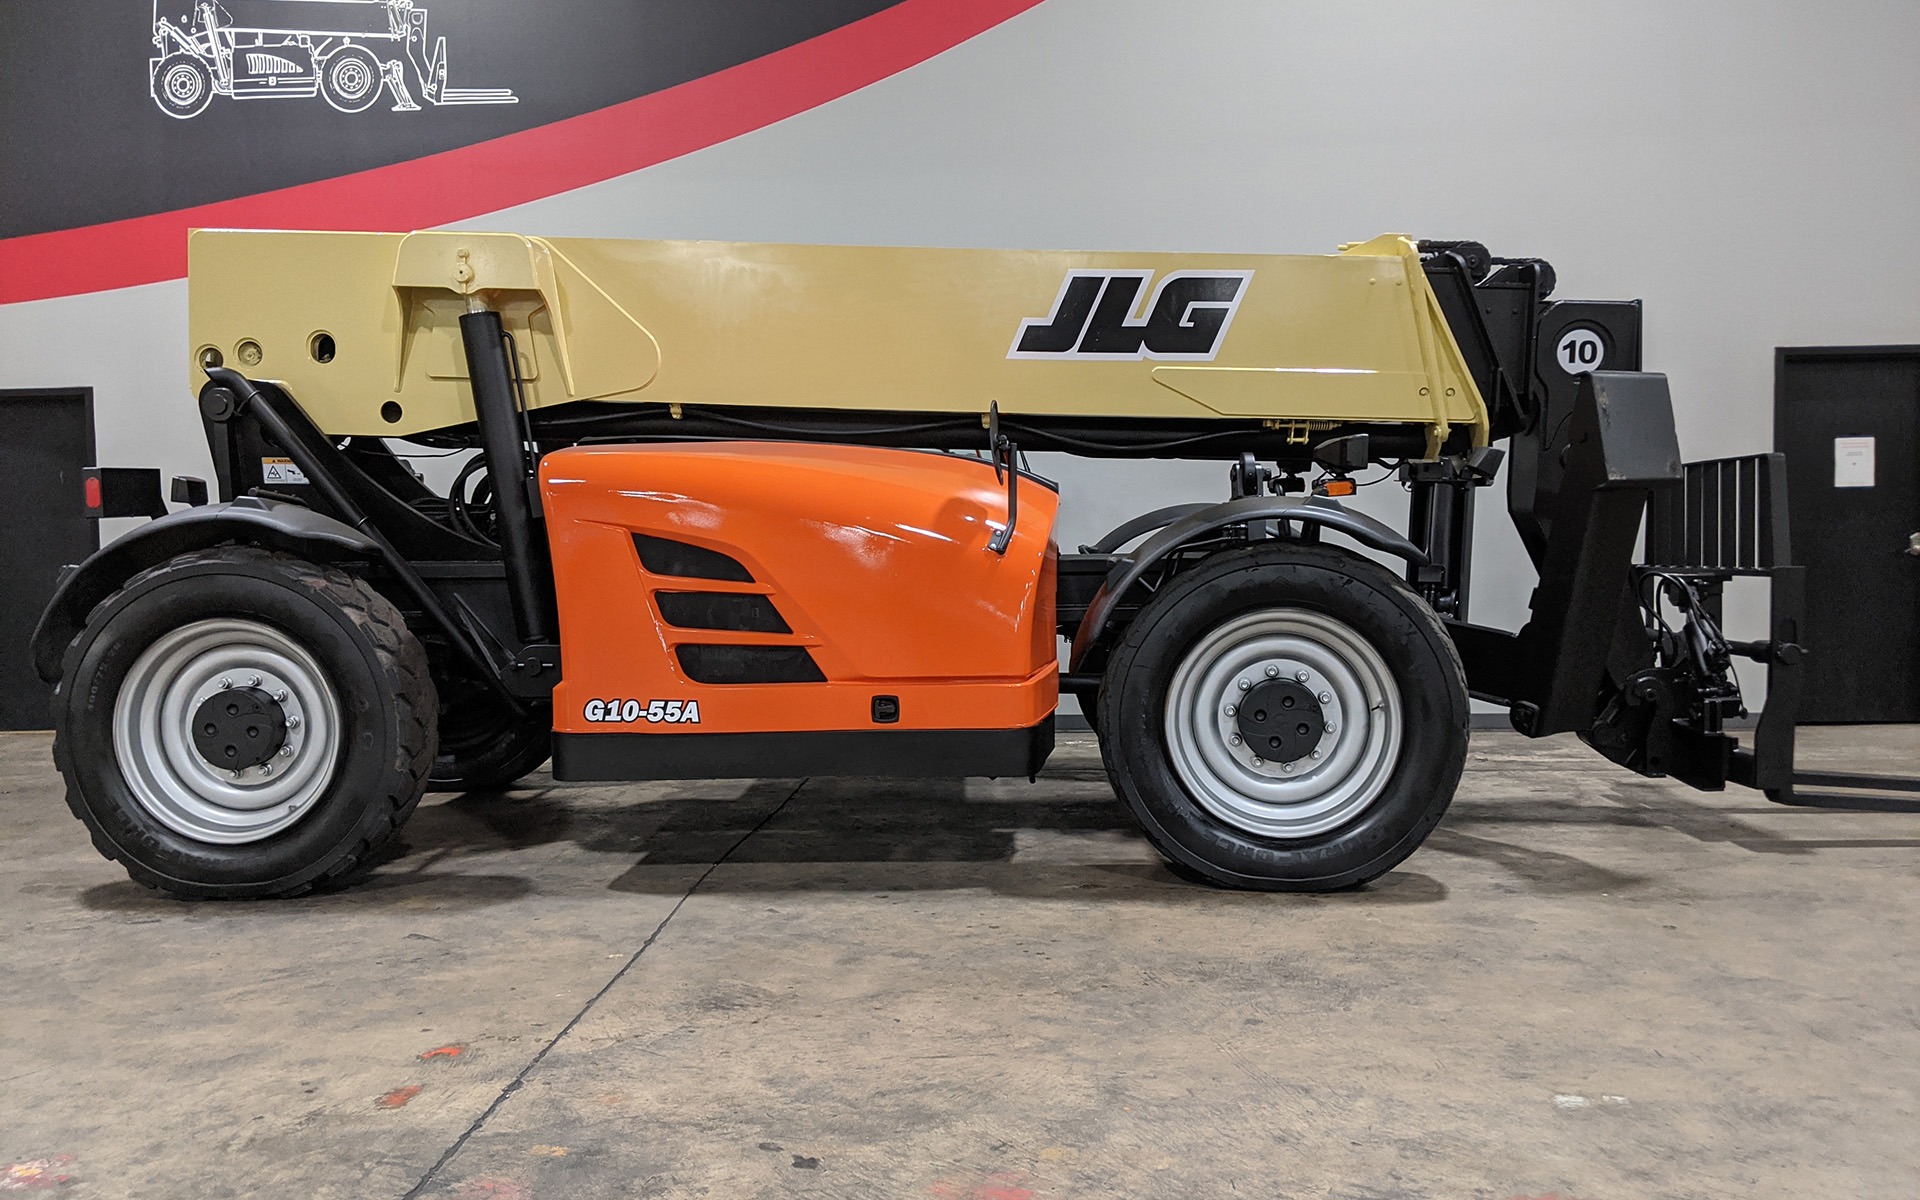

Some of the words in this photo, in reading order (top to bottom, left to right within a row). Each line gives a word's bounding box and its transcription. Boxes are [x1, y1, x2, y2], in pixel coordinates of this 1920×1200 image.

[1013, 275, 1247, 355] JLG
[1562, 339, 1598, 365] 10
[584, 699, 701, 723] G10-55A
